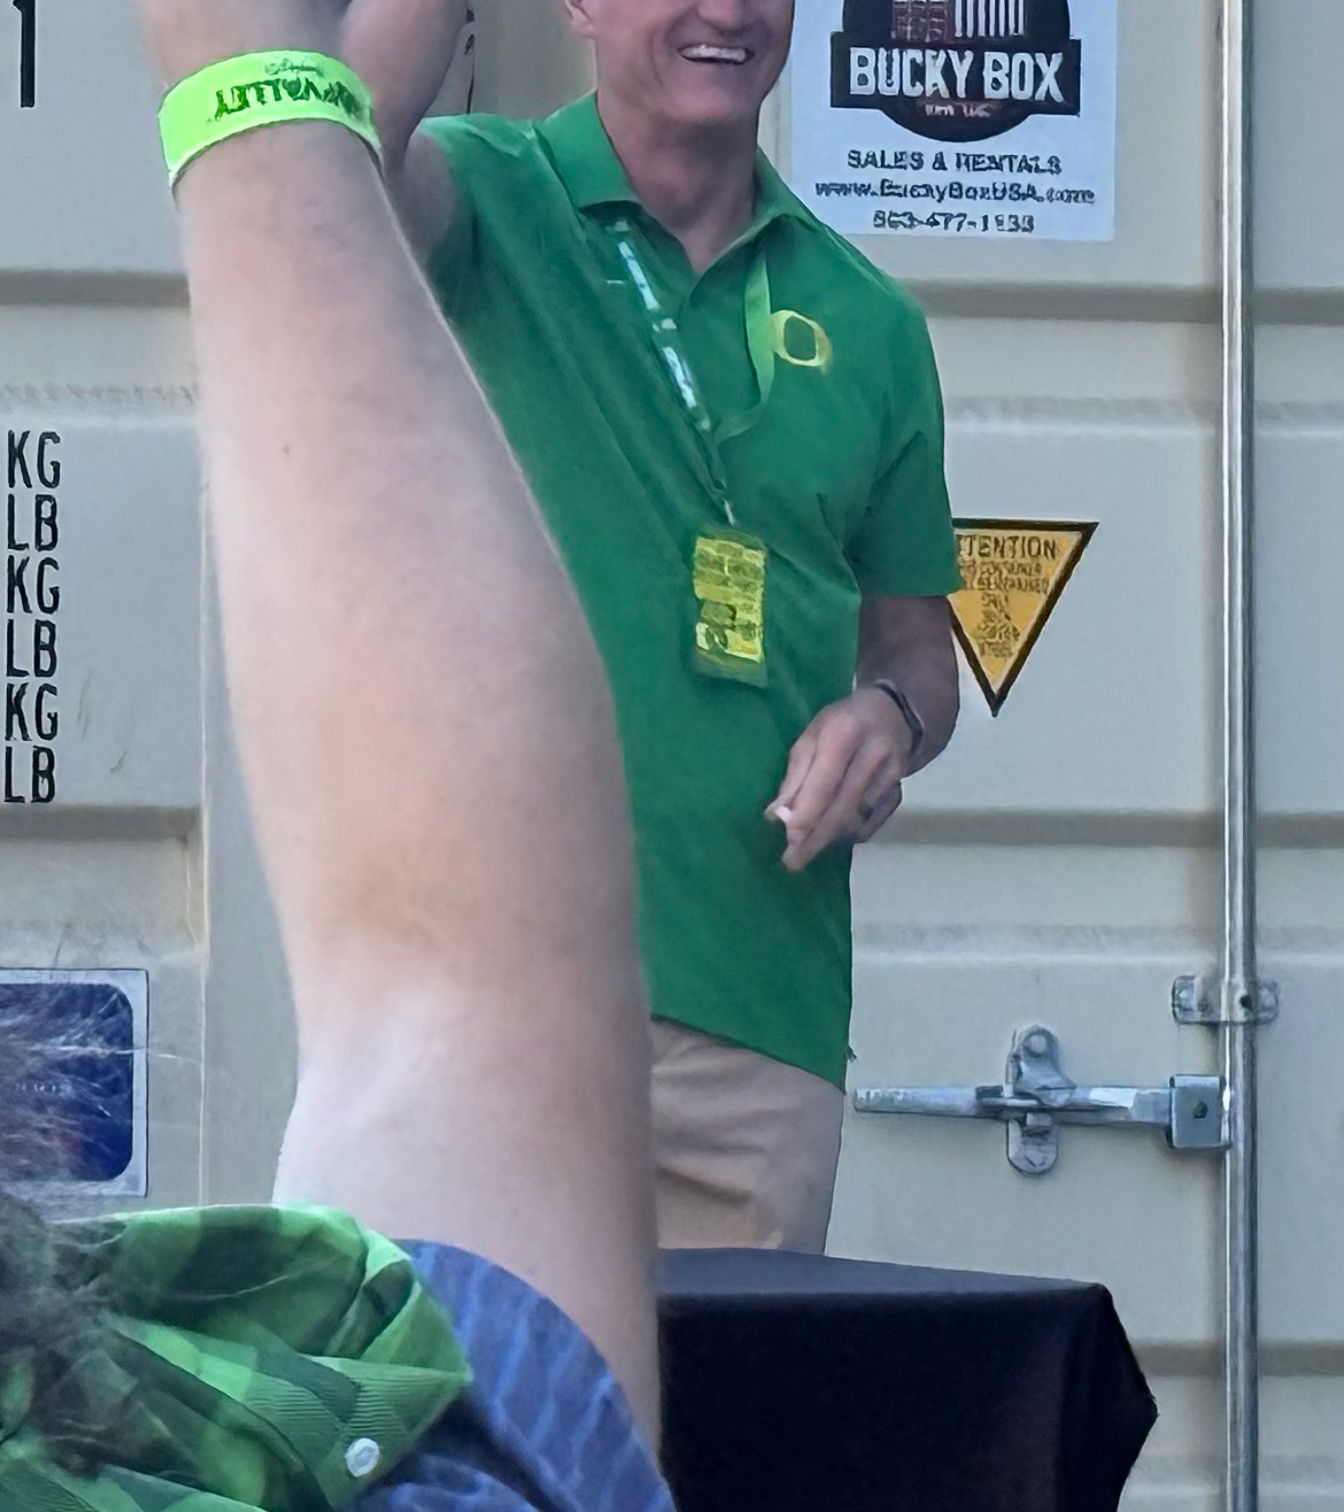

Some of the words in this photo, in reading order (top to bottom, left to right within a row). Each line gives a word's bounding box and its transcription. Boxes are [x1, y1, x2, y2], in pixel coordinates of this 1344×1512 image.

[849, 46, 974, 99] BUCKY
[981, 51, 1064, 104] BOX
[847, 148, 925, 172] SALES
[931, 150, 949, 172] &
[7, 429, 61, 489] KG
[7, 493, 60, 553] LB
[956, 534, 1057, 559] TENTION
[6, 554, 60, 615] KG
[5, 618, 58, 678] LB
[4, 682, 59, 742] KG
[3, 745, 56, 804] LB
